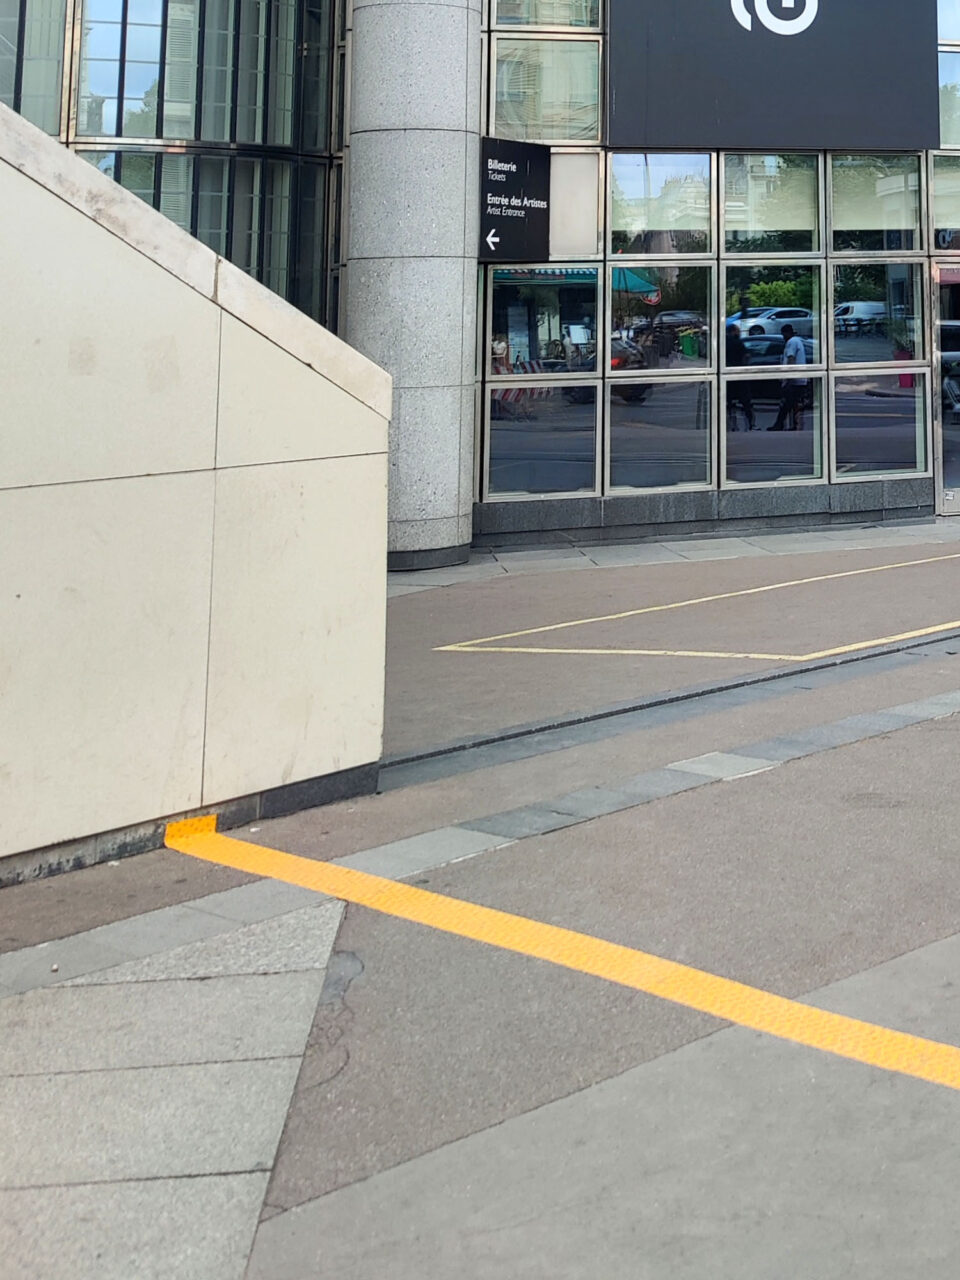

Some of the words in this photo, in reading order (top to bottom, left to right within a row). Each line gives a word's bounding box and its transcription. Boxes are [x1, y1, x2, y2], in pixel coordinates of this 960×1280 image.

[488, 171, 507, 181] Tickets
[487, 193, 509, 205] Entrée
[510, 196, 522, 206] des
[522, 196, 548, 208] Artistes
[486, 205, 501, 215] Artist
[502, 206, 526, 217] Entrance
